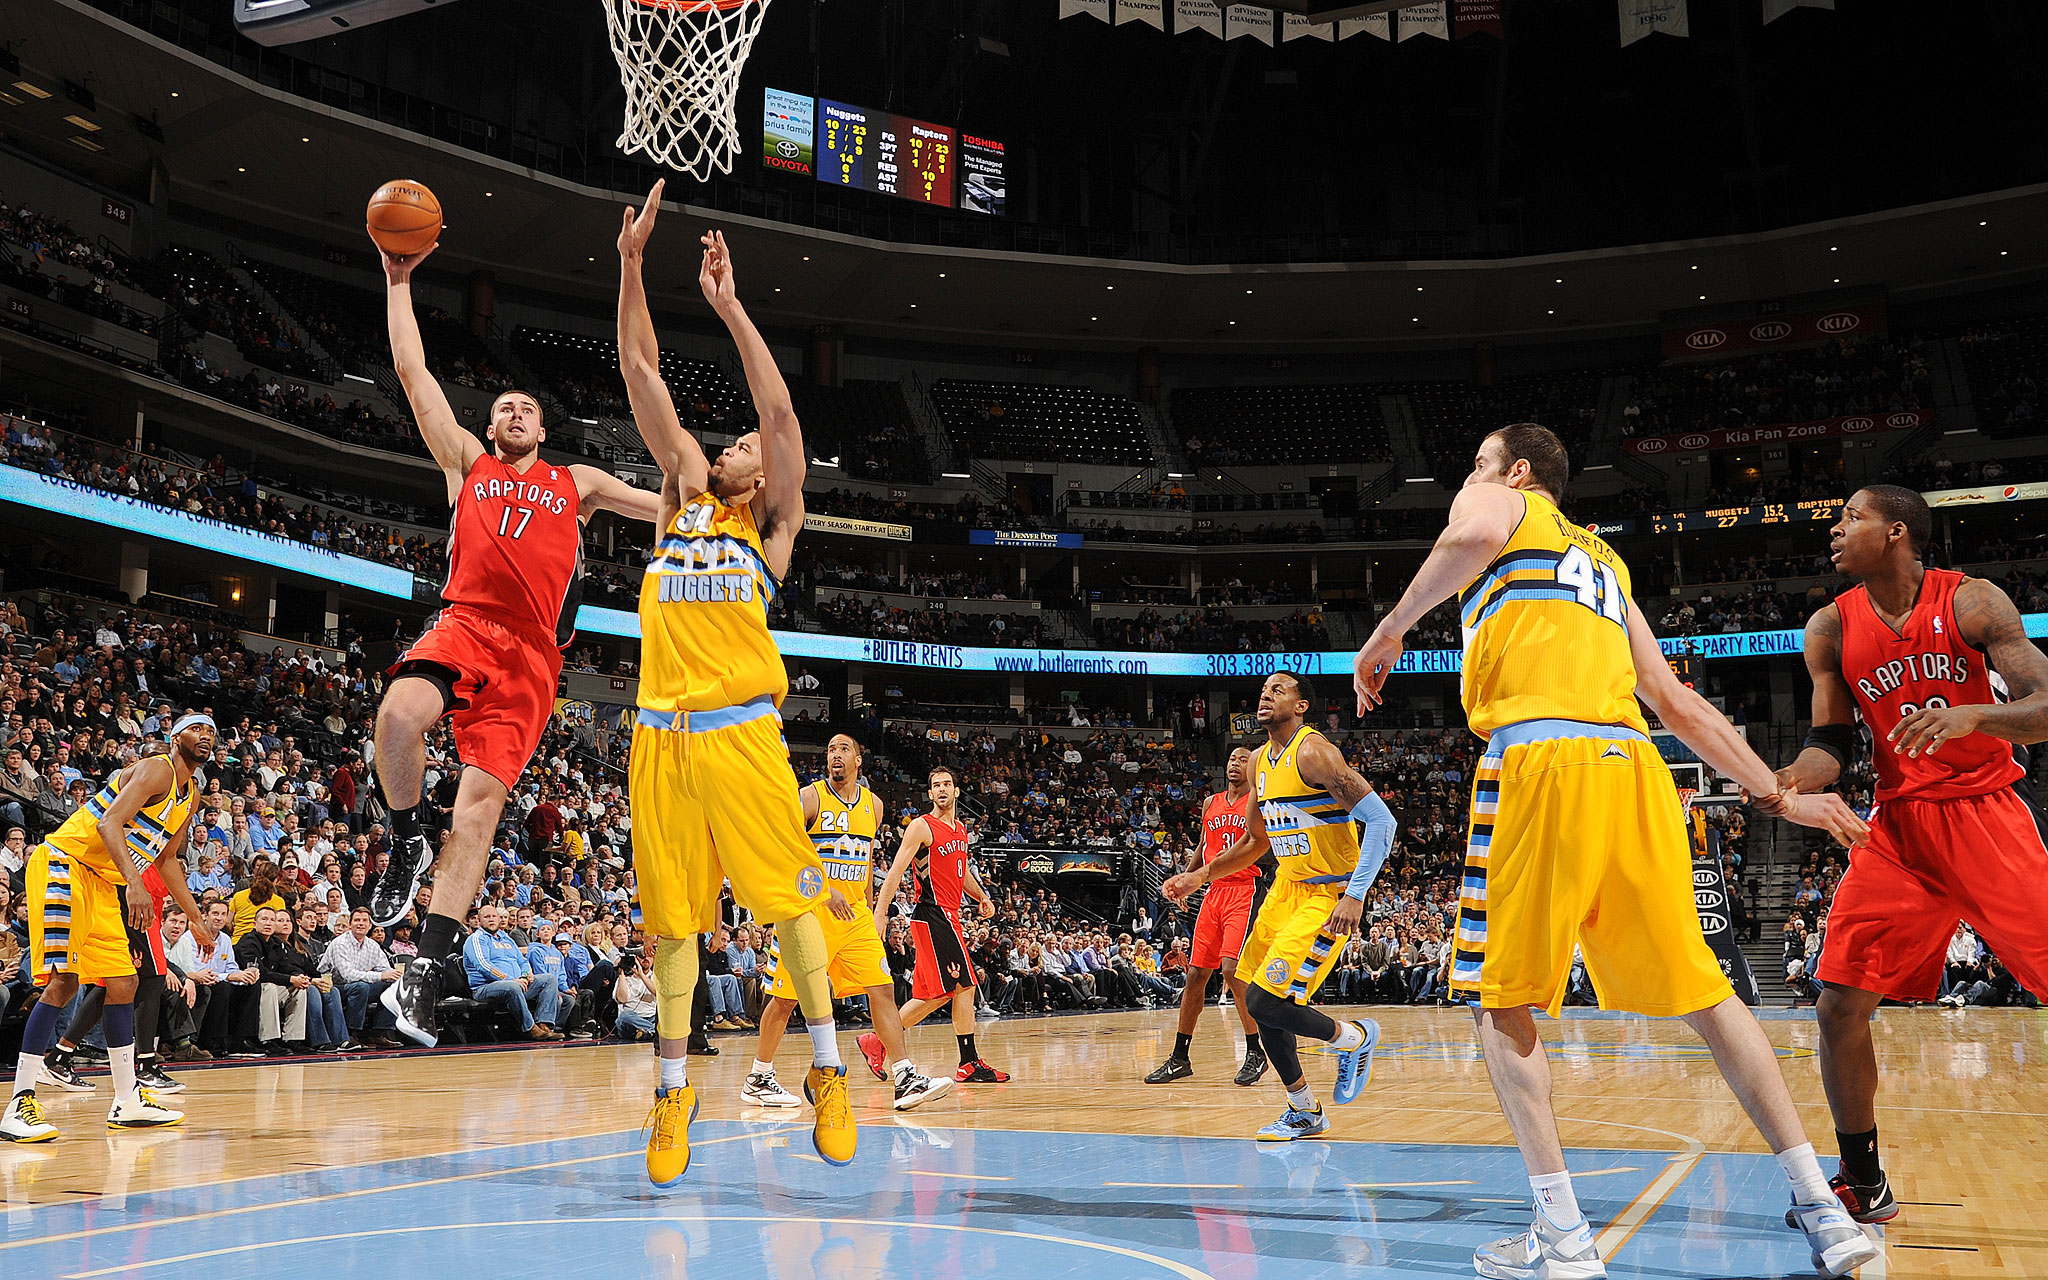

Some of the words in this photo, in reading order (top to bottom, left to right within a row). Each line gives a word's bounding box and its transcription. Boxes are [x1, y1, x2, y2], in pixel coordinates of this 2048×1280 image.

[1177, 7, 1220, 18] CHAMPIONS
[1234, 7, 1268, 17] DIVISION
[1460, 4, 1495, 12] DIVISION
[1229, 15, 1272, 27] CHAMPIONS
[1455, 13, 1501, 21] CHAMPIONS
[1639, 14, 1668, 26] 1996
[826, 106, 866, 123] Nuggets
[765, 119, 785, 130] prius
[787, 122, 812, 137] family
[825, 119, 840, 130] 10
[852, 124, 867, 136] 23
[912, 125, 949, 142] Raptors
[827, 129, 836, 139] 2
[881, 131, 896, 142] FG
[827, 140, 836, 150] 5
[879, 141, 898, 153] 3PT
[909, 138, 923, 149] 10
[935, 143, 949, 155] 23
[962, 134, 1005, 151] TOSHIBA
[840, 153, 854, 164] 14
[881, 152, 894, 162] FT
[912, 148, 919, 158] 1
[765, 155, 811, 174] TOYOTA
[877, 161, 898, 173] REB
[912, 158, 919, 168] 1
[938, 164, 945, 174] 1
[963, 154, 975, 163] The
[976, 156, 1003, 169] Managed
[964, 161, 979, 171] Print
[979, 164, 1002, 175] Experts
[841, 174, 850, 184] 3
[877, 172, 898, 183] AST
[921, 171, 936, 181] 10
[877, 182, 897, 194] STL
[924, 181, 933, 191] 4
[924, 191, 931, 201] 1
[106, 204, 127, 220] 348
[10, 300, 30, 315] 345
[1725, 432, 1750, 444] Kia
[1754, 428, 1783, 441] Fan
[1787, 424, 1827, 438] Zone
[473, 478, 568, 515] RAPTORS
[1797, 498, 1844, 510] RAPTORS
[1705, 507, 1750, 518] NUGGETS
[1763, 503, 1784, 518] 15.2
[1811, 507, 1833, 520] 22
[497, 505, 534, 540] 17
[675, 502, 716, 534] 34
[1718, 516, 1738, 528] 27
[1782, 514, 1790, 523] 1
[805, 518, 826, 527] EVERY
[827, 520, 853, 530] SEASON
[854, 524, 877, 533] STARTS
[888, 526, 910, 537] DICK'S
[1600, 524, 1623, 534] pepsi
[1677, 521, 1683, 532] 3
[994, 530, 1010, 539] THE
[1011, 530, 1039, 540] DENVER
[1040, 531, 1058, 541] POST
[658, 573, 754, 603] NUGGETS
[1556, 543, 1623, 629] 41
[1757, 585, 1774, 593] 246
[929, 602, 944, 610] 240
[1703, 636, 1743, 656] PARTY
[1749, 633, 1800, 653] RENTAL
[873, 640, 917, 664] BUTLER
[922, 644, 963, 668] RENTS
[994, 650, 1148, 675] www.butlerrents.com
[1206, 653, 1322, 675] 303.3885971
[1857, 652, 1969, 703] RAPTORS
[1236, 720, 1250, 730] DIG
[1257, 770, 1266, 798] 9
[820, 810, 849, 832] 24
[957, 858, 963, 879] 8
[1030, 865, 1054, 873] ROCKS
[1693, 874, 1714, 883] KIA
[1694, 894, 1717, 904] KIA
